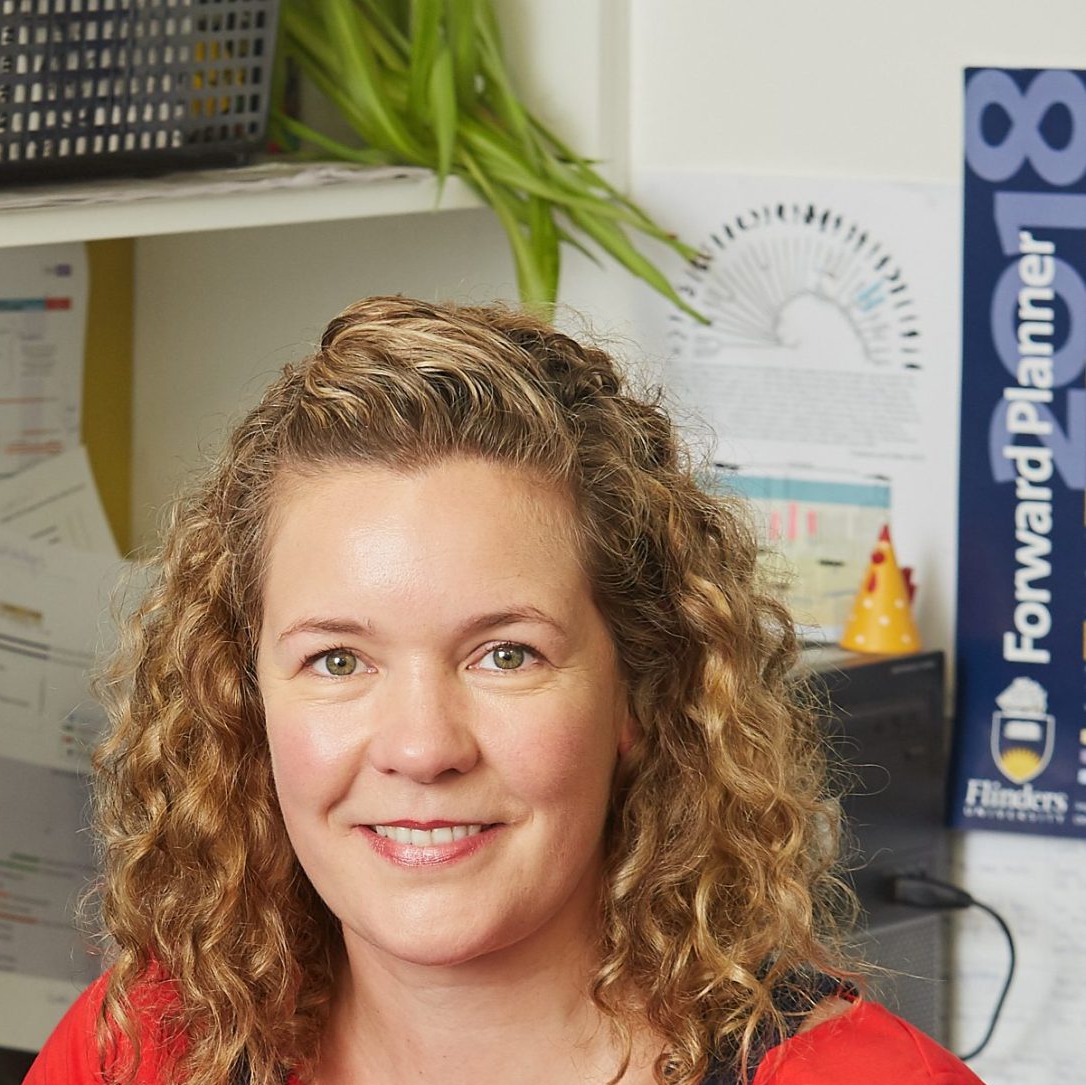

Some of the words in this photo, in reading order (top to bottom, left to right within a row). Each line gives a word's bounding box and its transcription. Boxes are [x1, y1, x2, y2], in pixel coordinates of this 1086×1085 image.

[1003, 231, 1056, 434] Planner
[1003, 446, 1053, 664] Forward
[966, 778, 1069, 813] Flinders
